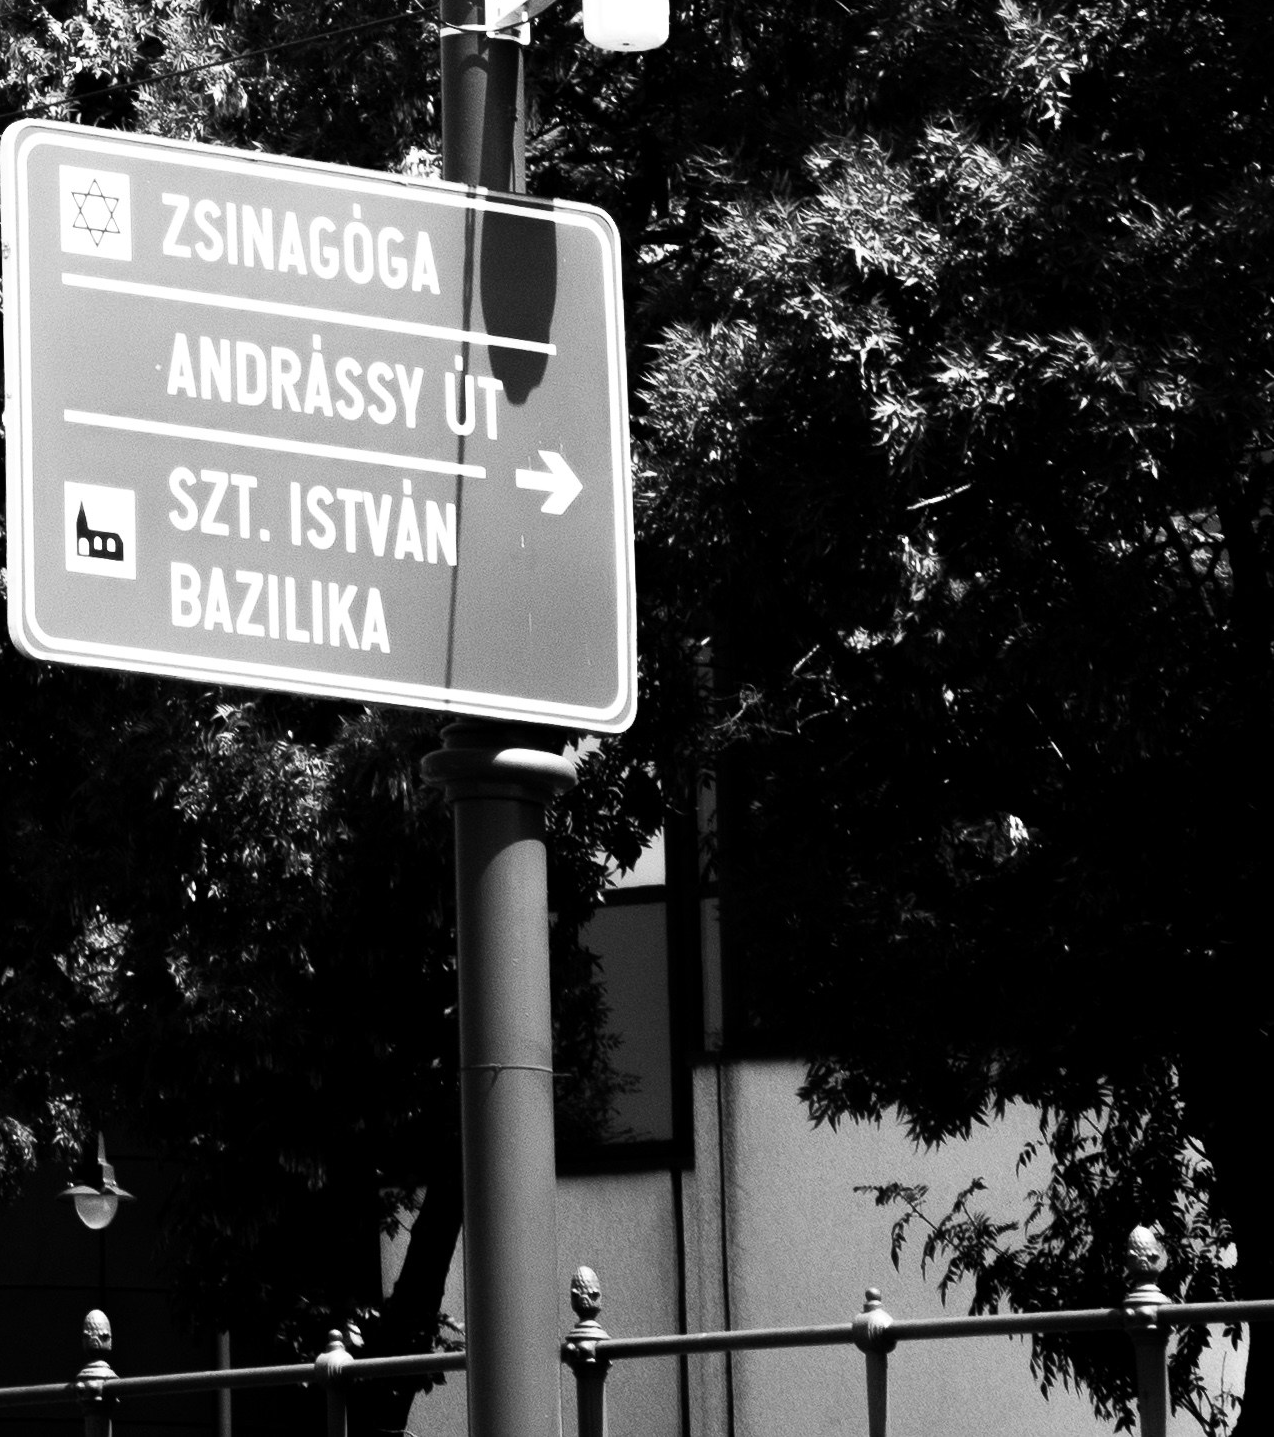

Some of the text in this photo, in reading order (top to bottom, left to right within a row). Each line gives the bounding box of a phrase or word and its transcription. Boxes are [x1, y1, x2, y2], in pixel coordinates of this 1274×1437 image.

[161, 192, 441, 295] ZSINAGÓGA
[166, 332, 504, 440] ANDRÁSSY ÚT
[168, 466, 458, 566] SZT. ISTVÁN
[170, 561, 391, 653] BAZILIKA
